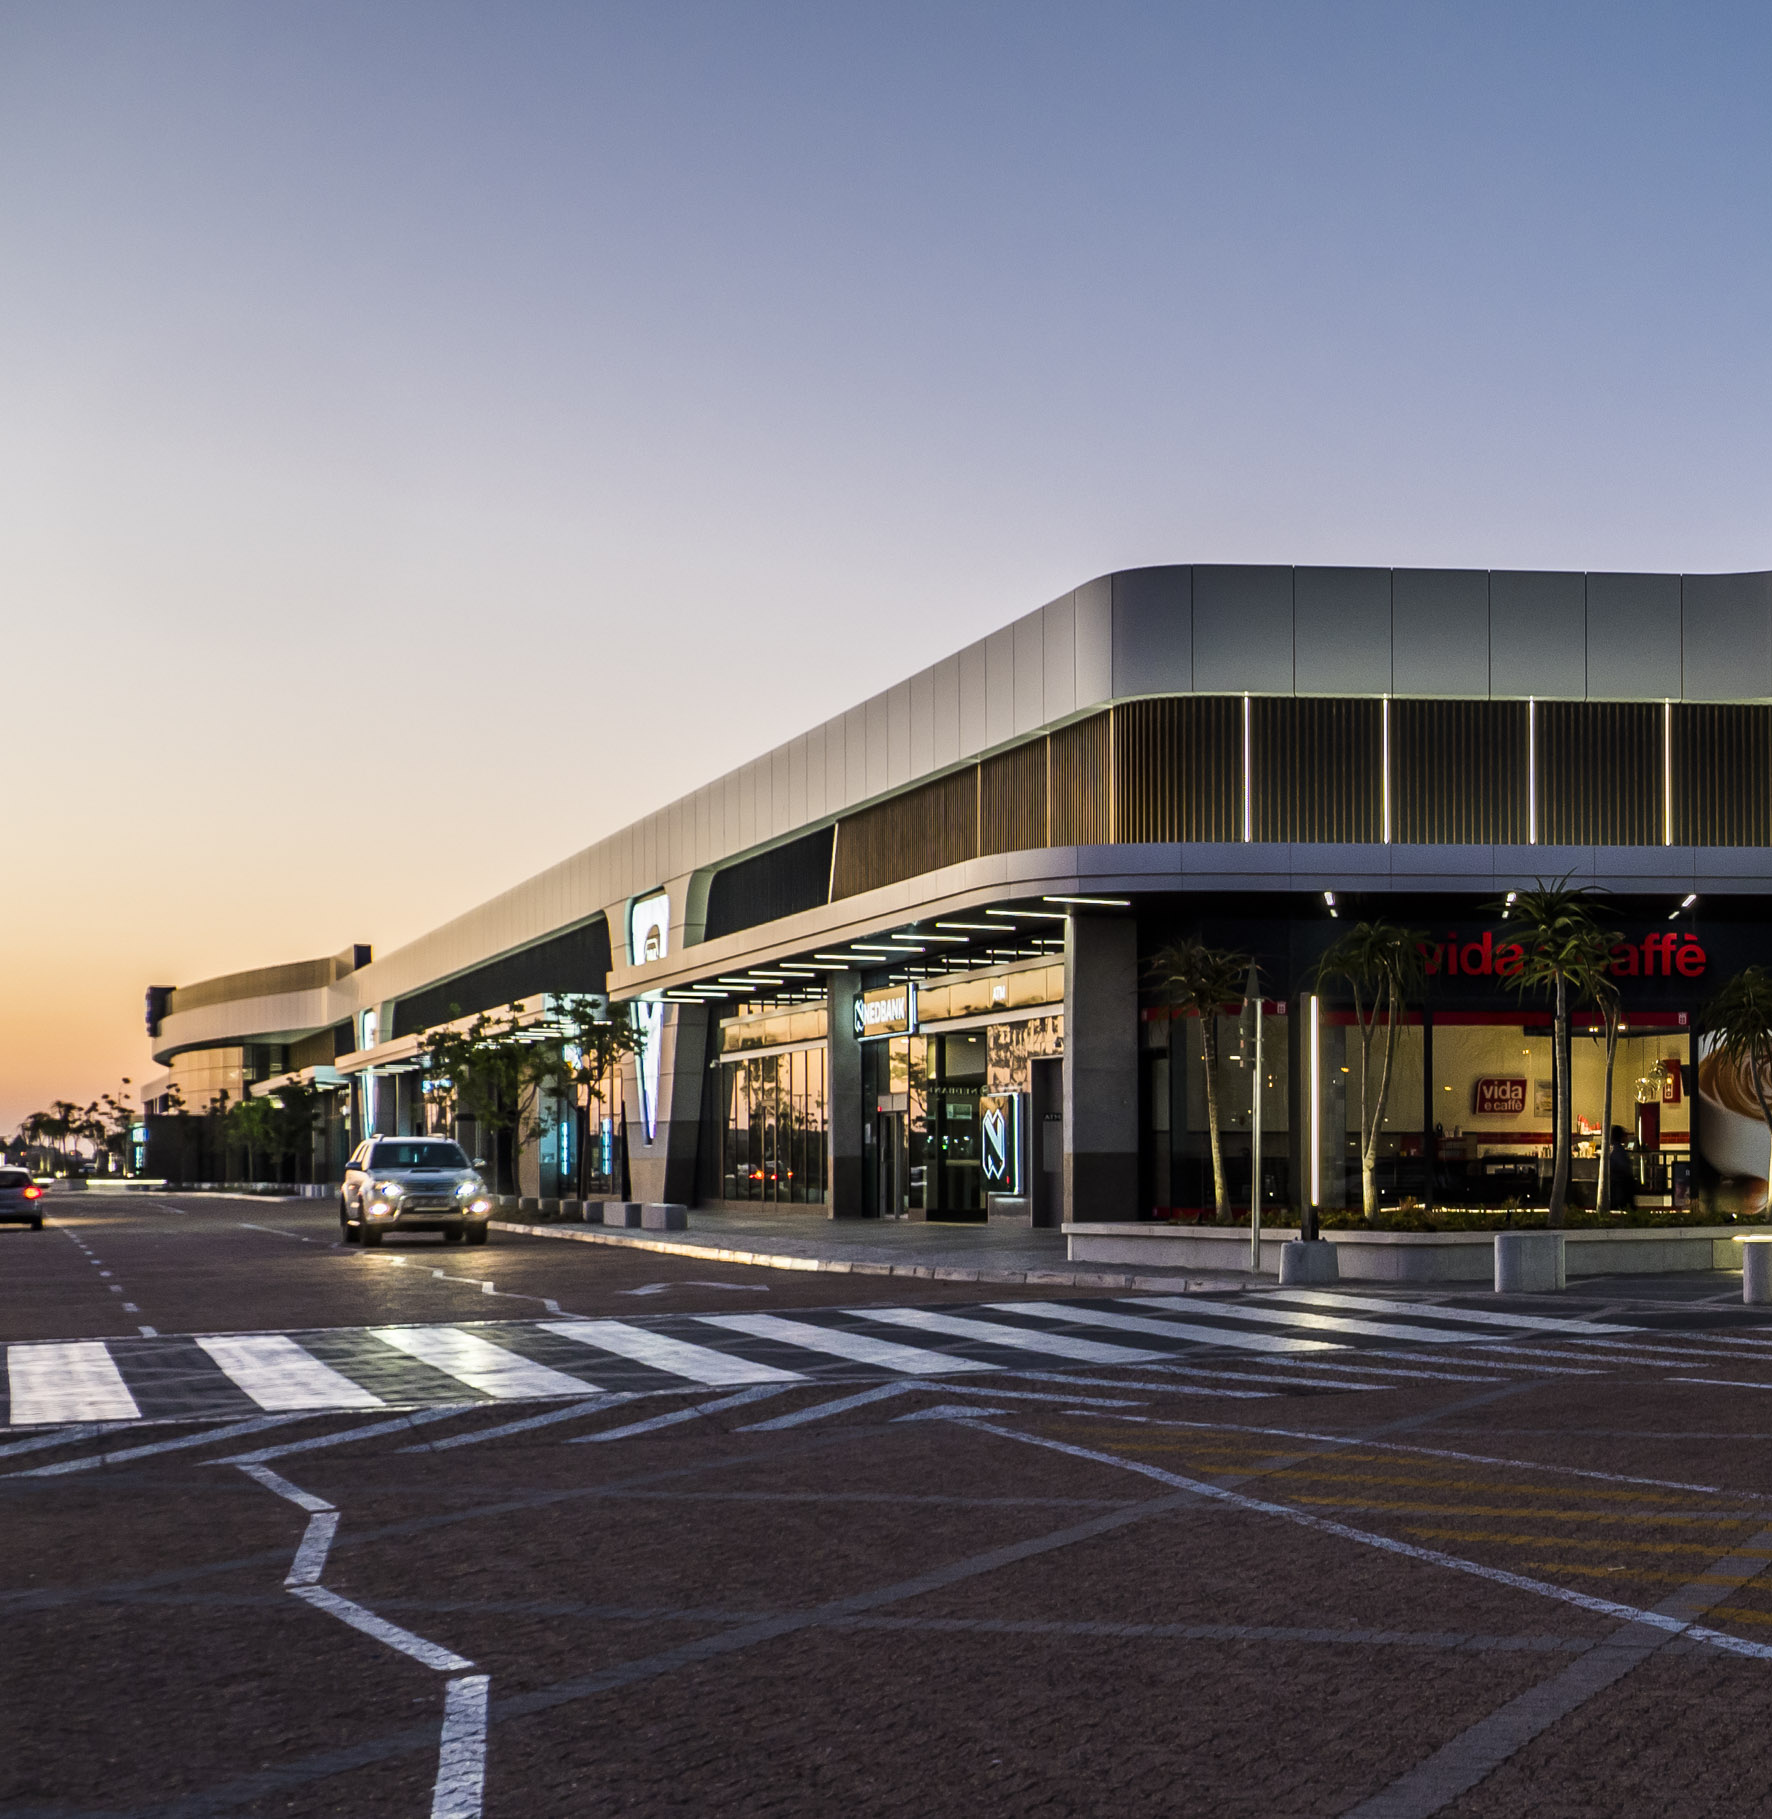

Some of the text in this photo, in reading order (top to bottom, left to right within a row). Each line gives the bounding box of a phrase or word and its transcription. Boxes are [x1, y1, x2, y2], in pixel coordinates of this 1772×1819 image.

[1417, 932, 1524, 976] vida
[1576, 932, 1707, 977] affè
[864, 997, 905, 1025] NEDBANK
[1482, 1081, 1522, 1099] vida
[1484, 1099, 1522, 1111] e caffè
